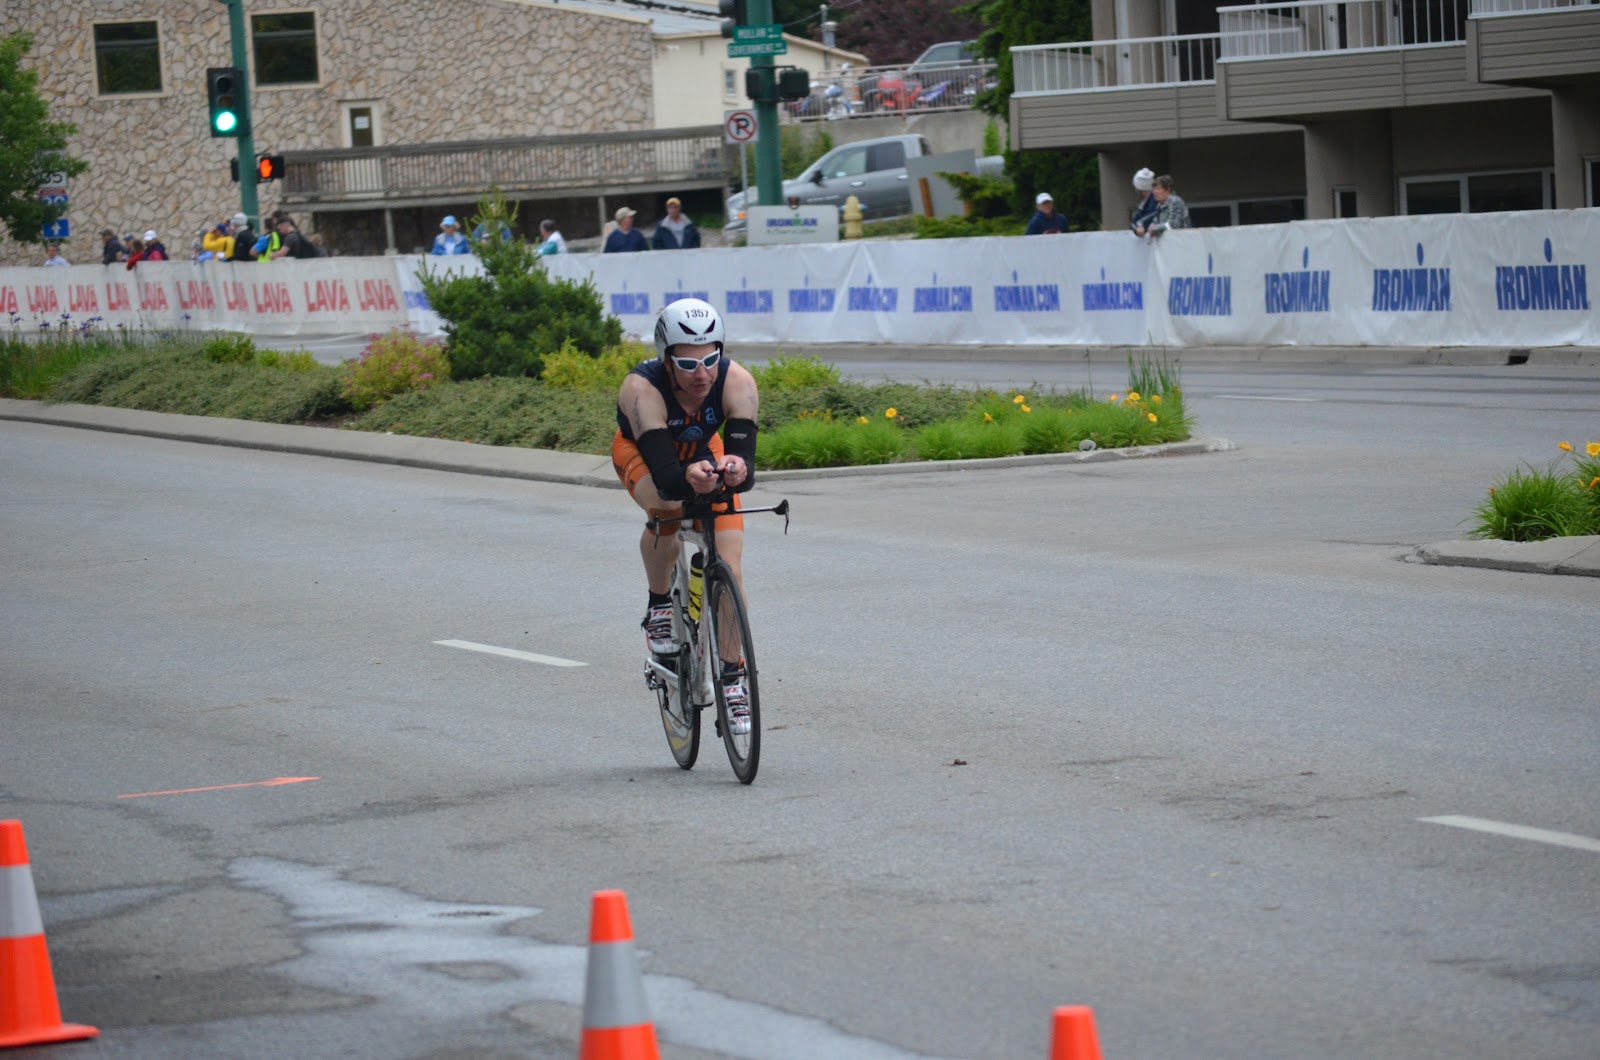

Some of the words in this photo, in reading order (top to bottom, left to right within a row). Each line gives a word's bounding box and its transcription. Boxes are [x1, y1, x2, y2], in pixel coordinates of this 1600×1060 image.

[304, 279, 351, 312] LAVA
[1168, 276, 1232, 316] IRONMAN
[1264, 270, 1331, 313] IRONMAN
[1371, 268, 1451, 312] IRONMAN
[1496, 265, 1590, 311] IRONMAN
[684, 308, 709, 319] 1357
